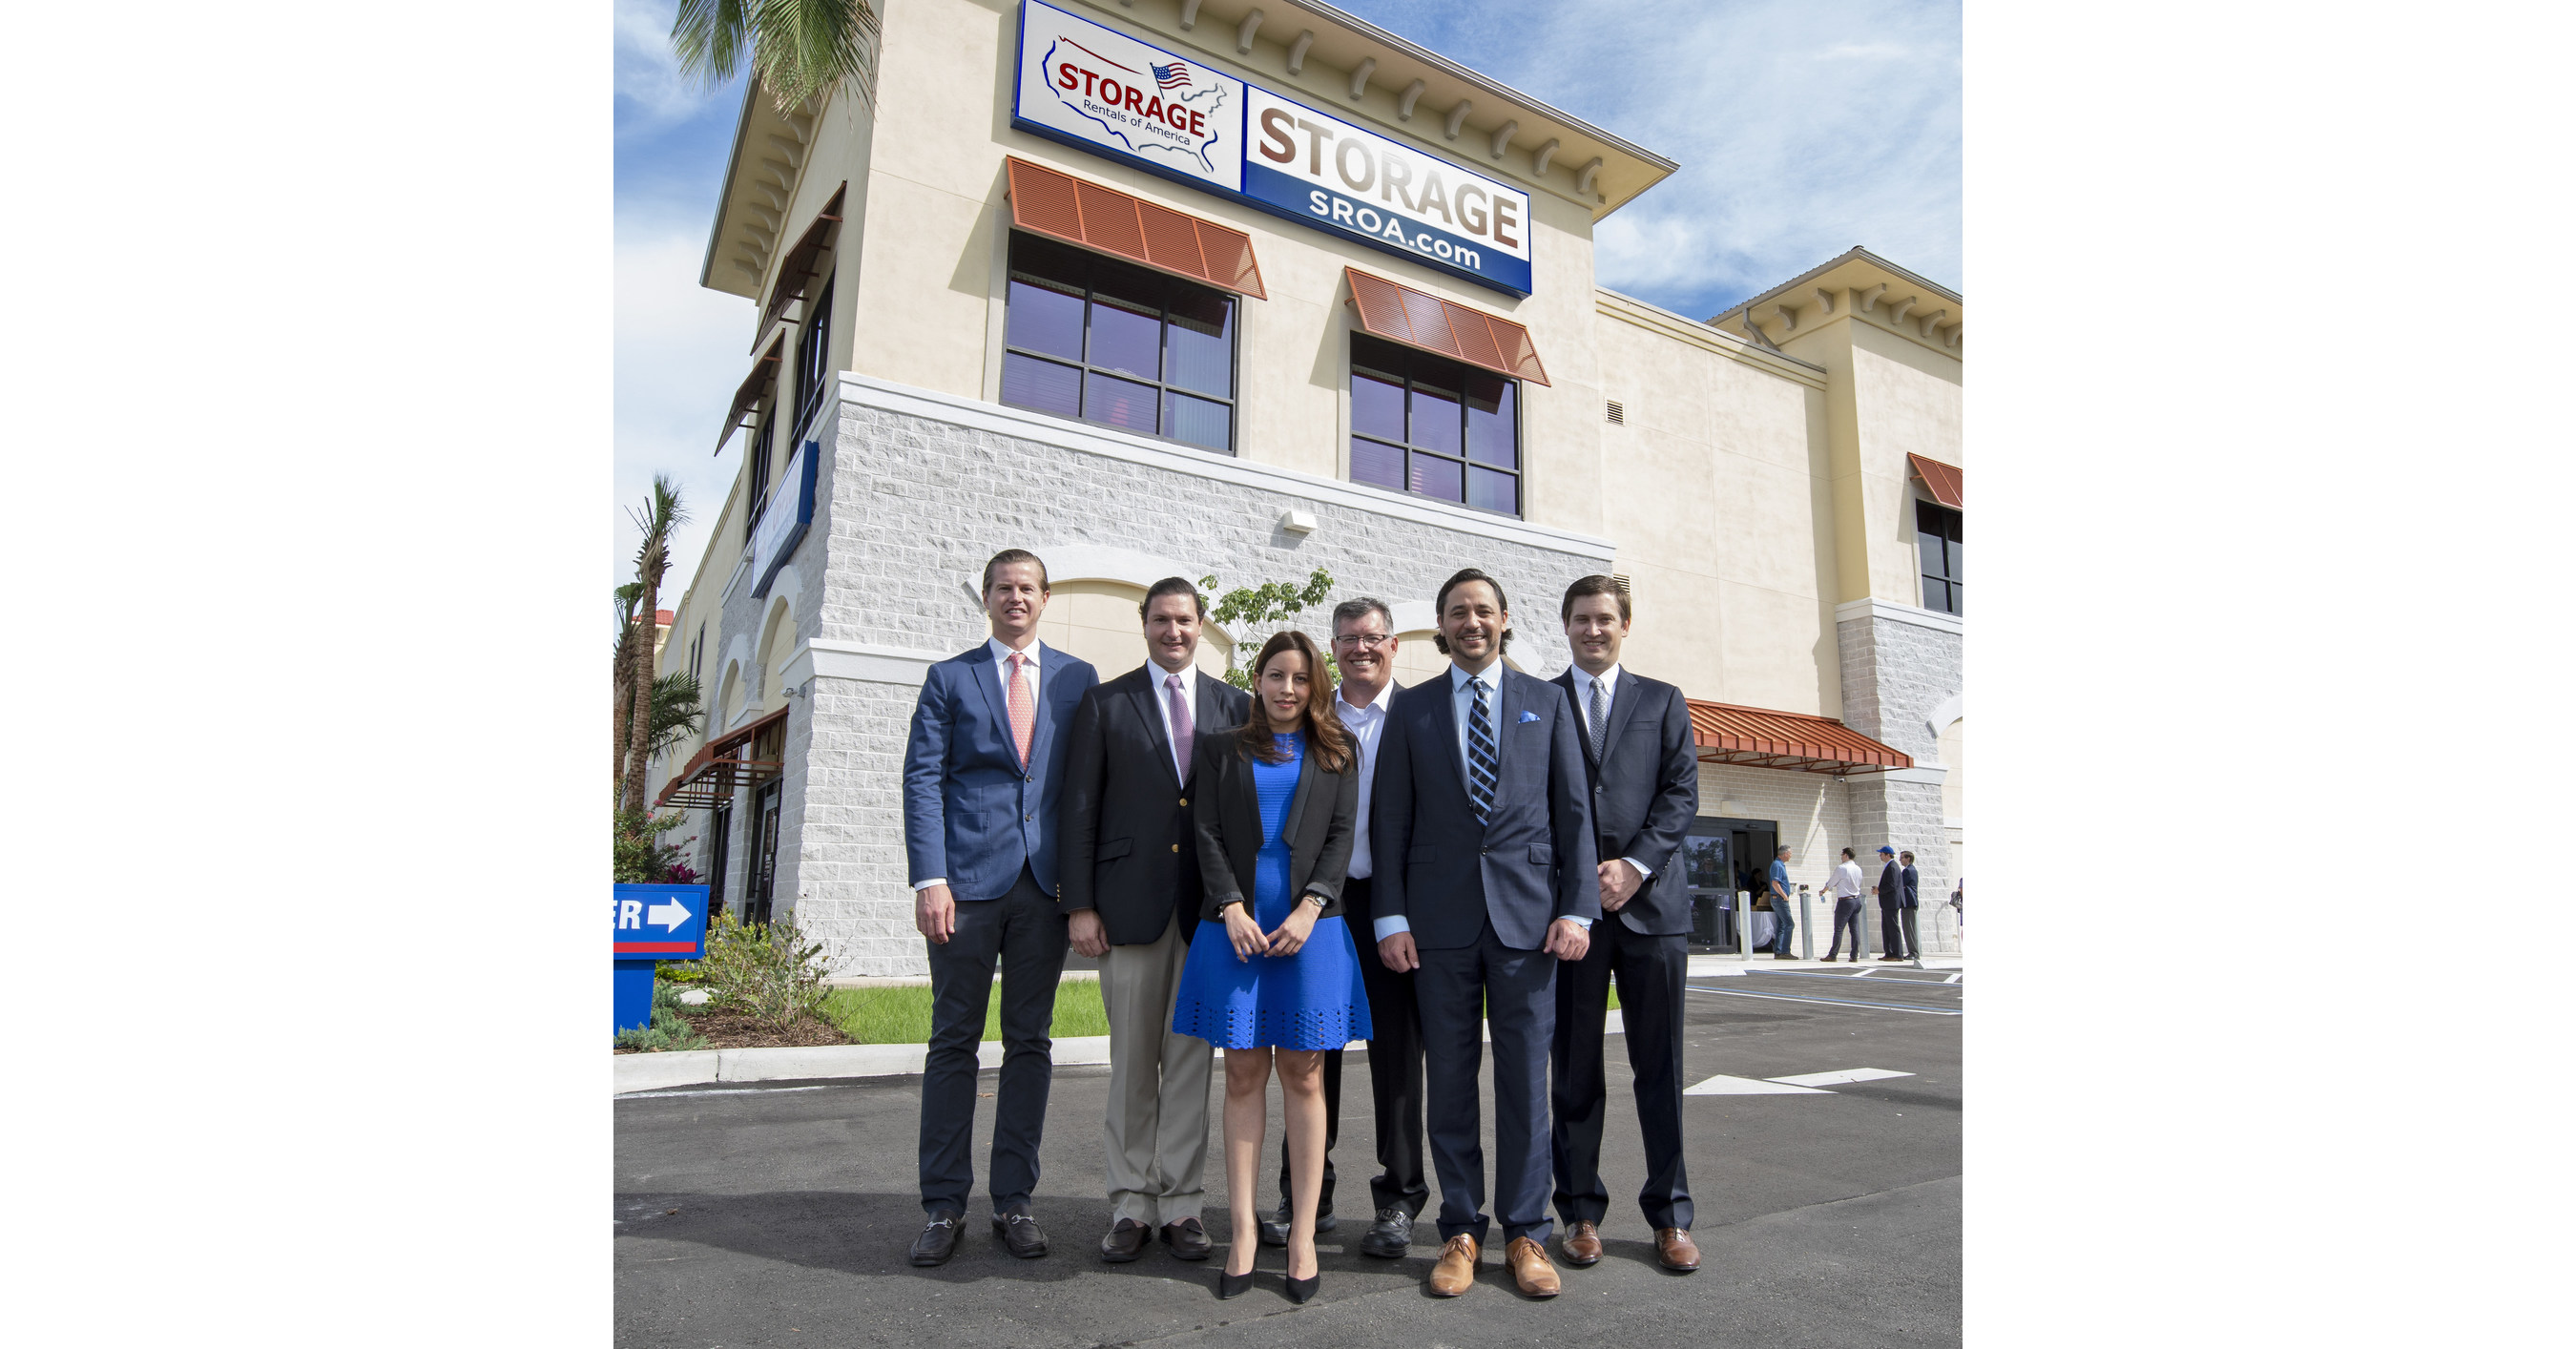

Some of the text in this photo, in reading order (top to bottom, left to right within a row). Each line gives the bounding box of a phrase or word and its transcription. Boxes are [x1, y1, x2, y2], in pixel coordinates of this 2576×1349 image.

[1058, 62, 1205, 138] STORAGE
[1083, 99, 1191, 146] Rentals of America
[1259, 107, 1518, 250] STORAGE
[1308, 190, 1481, 271] SROA.com
